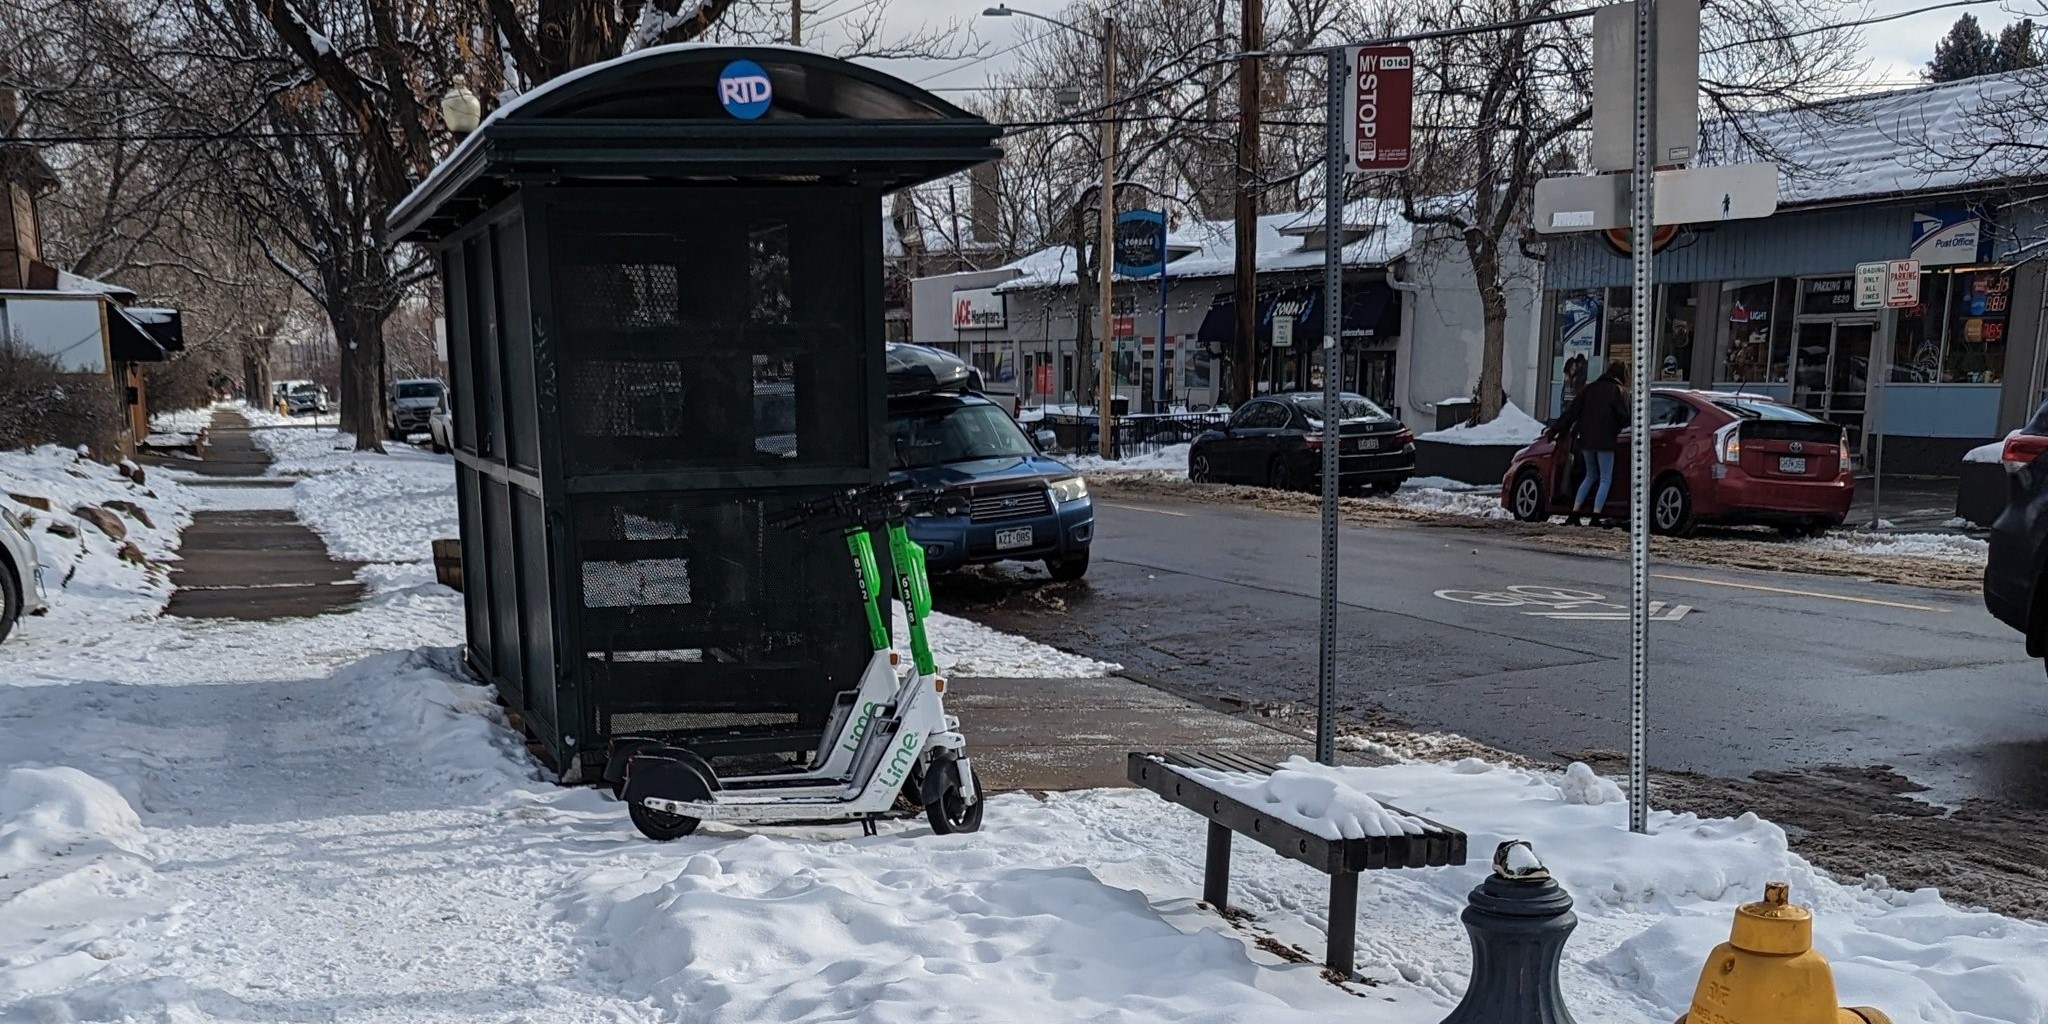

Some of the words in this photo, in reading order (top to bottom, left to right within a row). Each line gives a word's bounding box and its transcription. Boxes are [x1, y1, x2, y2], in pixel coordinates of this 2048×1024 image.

[1359, 55, 1378, 73] MY
[1382, 58, 1408, 68] 10163
[720, 76, 772, 105] RTD
[1358, 73, 1378, 138] STOP
[1935, 240, 1952, 248] Post
[1952, 238, 1975, 247] Office
[1859, 266, 1885, 275] LOADING
[1898, 262, 1910, 272] NO
[1863, 276, 1880, 284] ONLY
[1890, 271, 1917, 282] PARKING
[1813, 281, 1841, 292] PARKING
[954, 298, 972, 325] ACE
[1750, 311, 1768, 320] LIGHT
[853, 557, 869, 600] 8702
[842, 701, 874, 752] Lime
[879, 732, 919, 788] Lime
